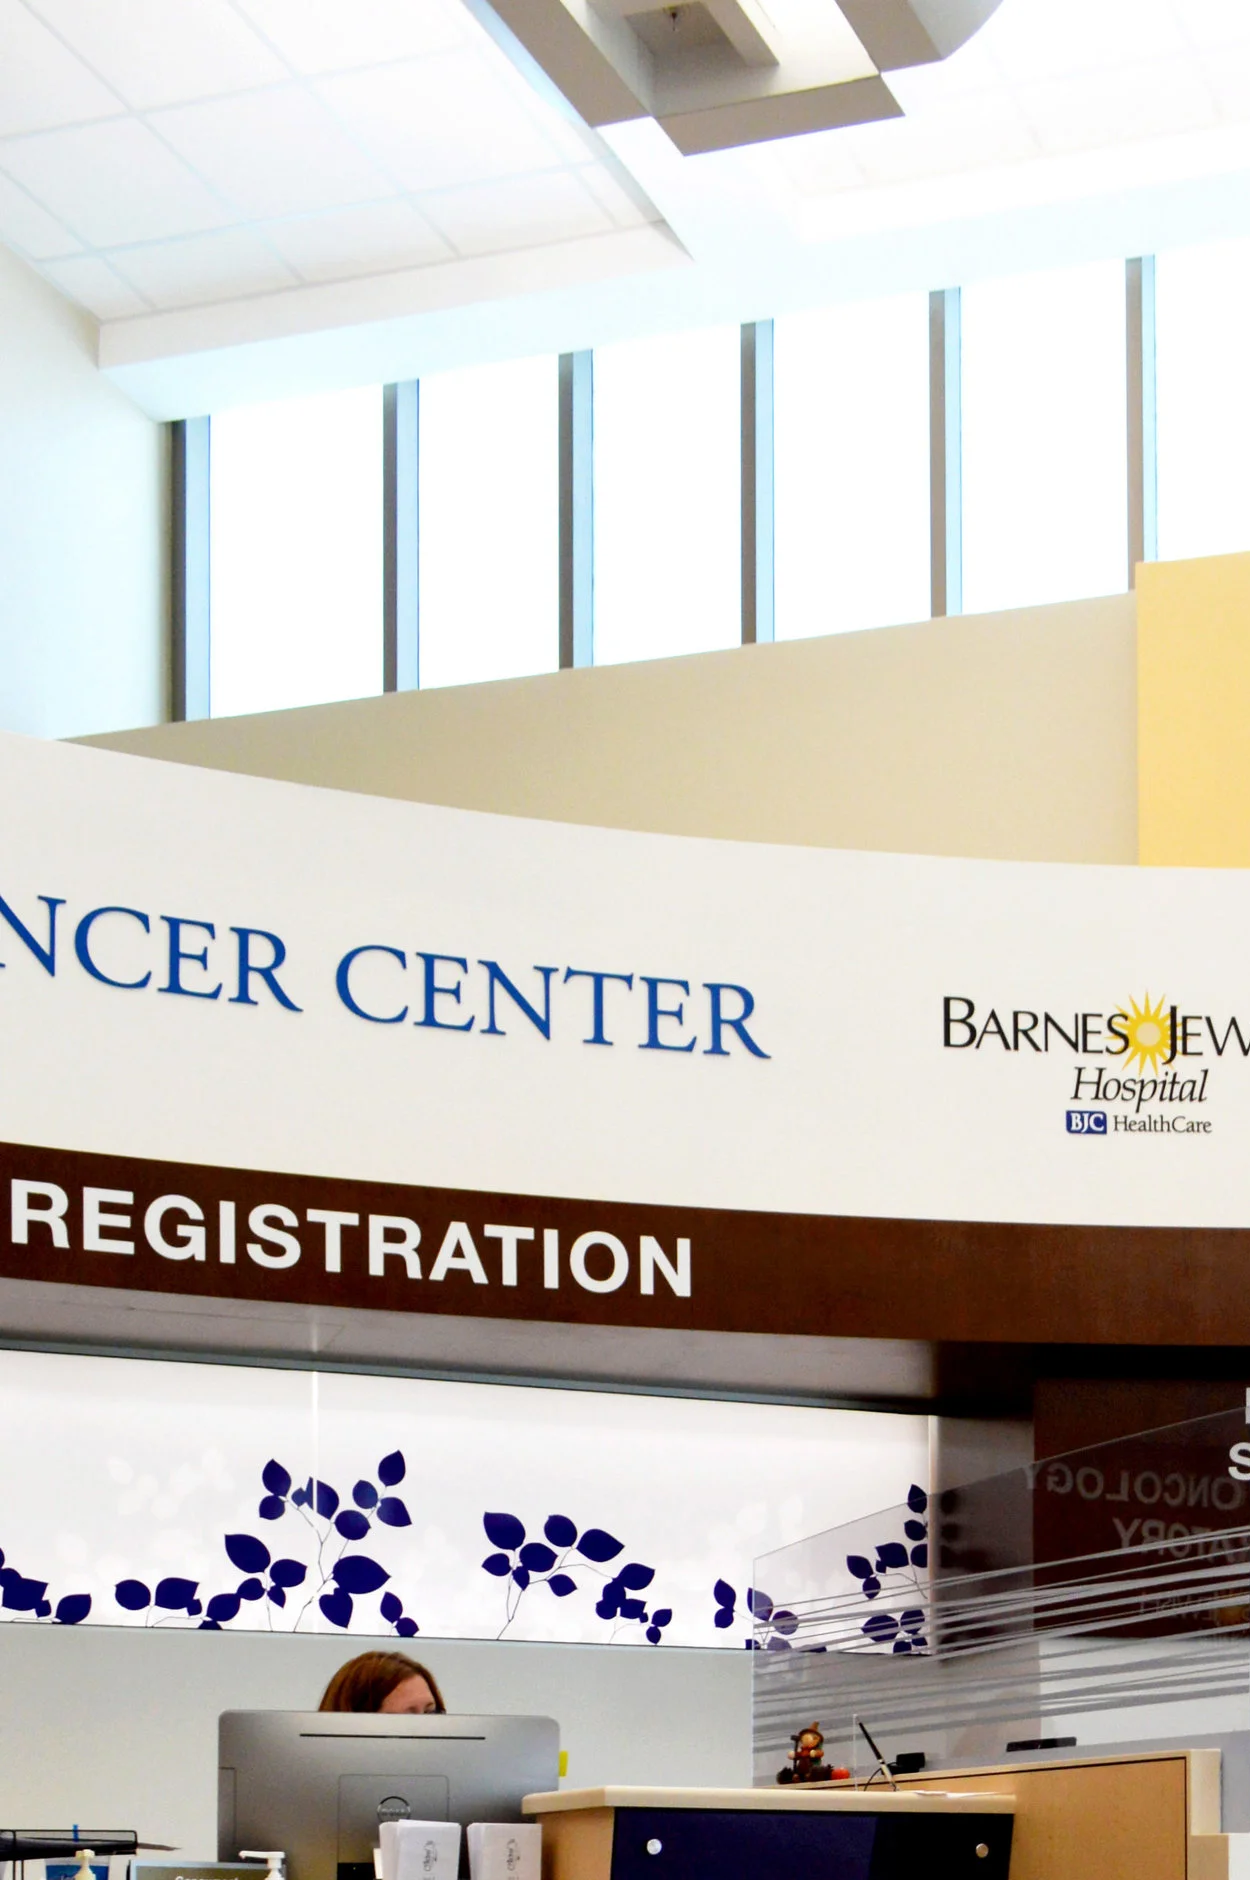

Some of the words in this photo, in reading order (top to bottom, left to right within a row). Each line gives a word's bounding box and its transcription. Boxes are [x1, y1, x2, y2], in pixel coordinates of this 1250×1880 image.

[335, 944, 772, 1059] CENTER
[943, 996, 1130, 1056] BARNES
[1070, 1066, 1210, 1113] Hospital
[1070, 1113, 1105, 1133] BJC
[1113, 1114, 1213, 1134] HealthCare
[10, 1178, 693, 1299] REGISTRATION
